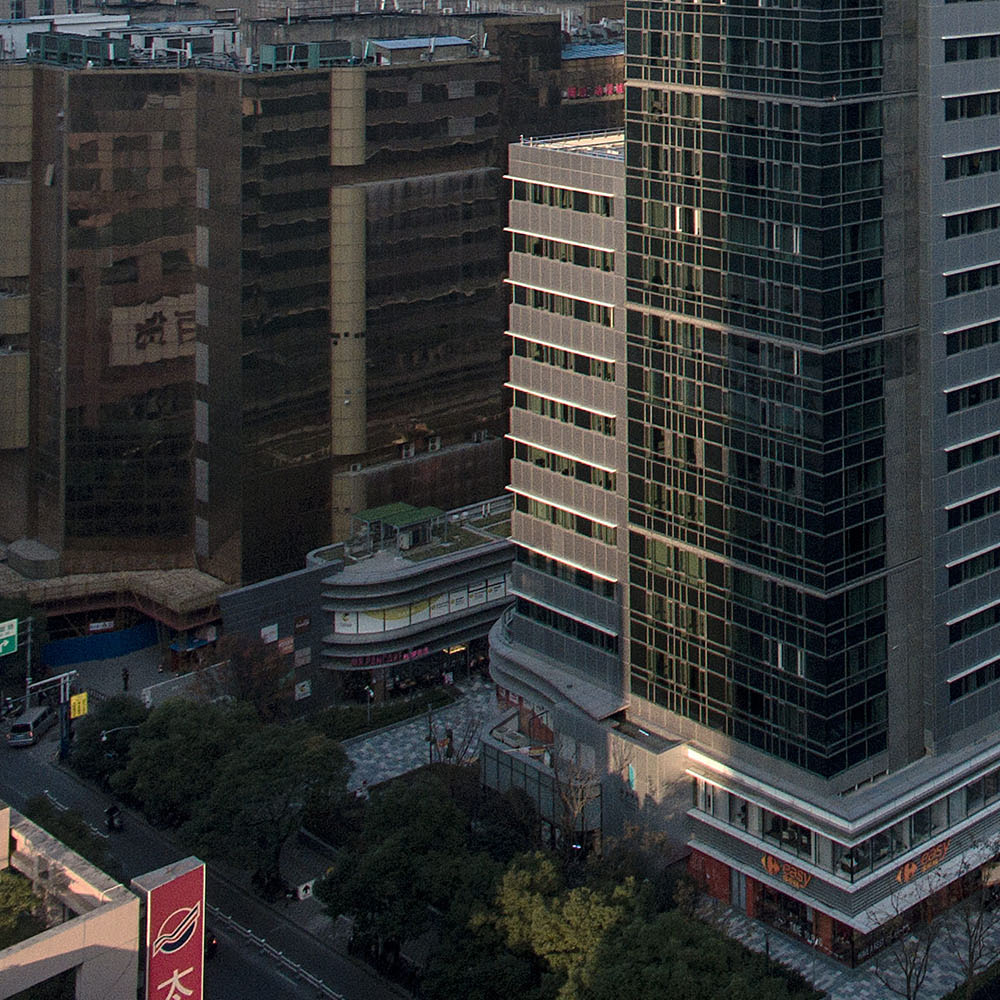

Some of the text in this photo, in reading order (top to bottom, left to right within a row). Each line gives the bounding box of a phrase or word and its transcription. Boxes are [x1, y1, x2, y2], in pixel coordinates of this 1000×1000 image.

[920, 839, 952, 865] easy
[782, 863, 812, 888] easy
[157, 966, 195, 1000] 太
